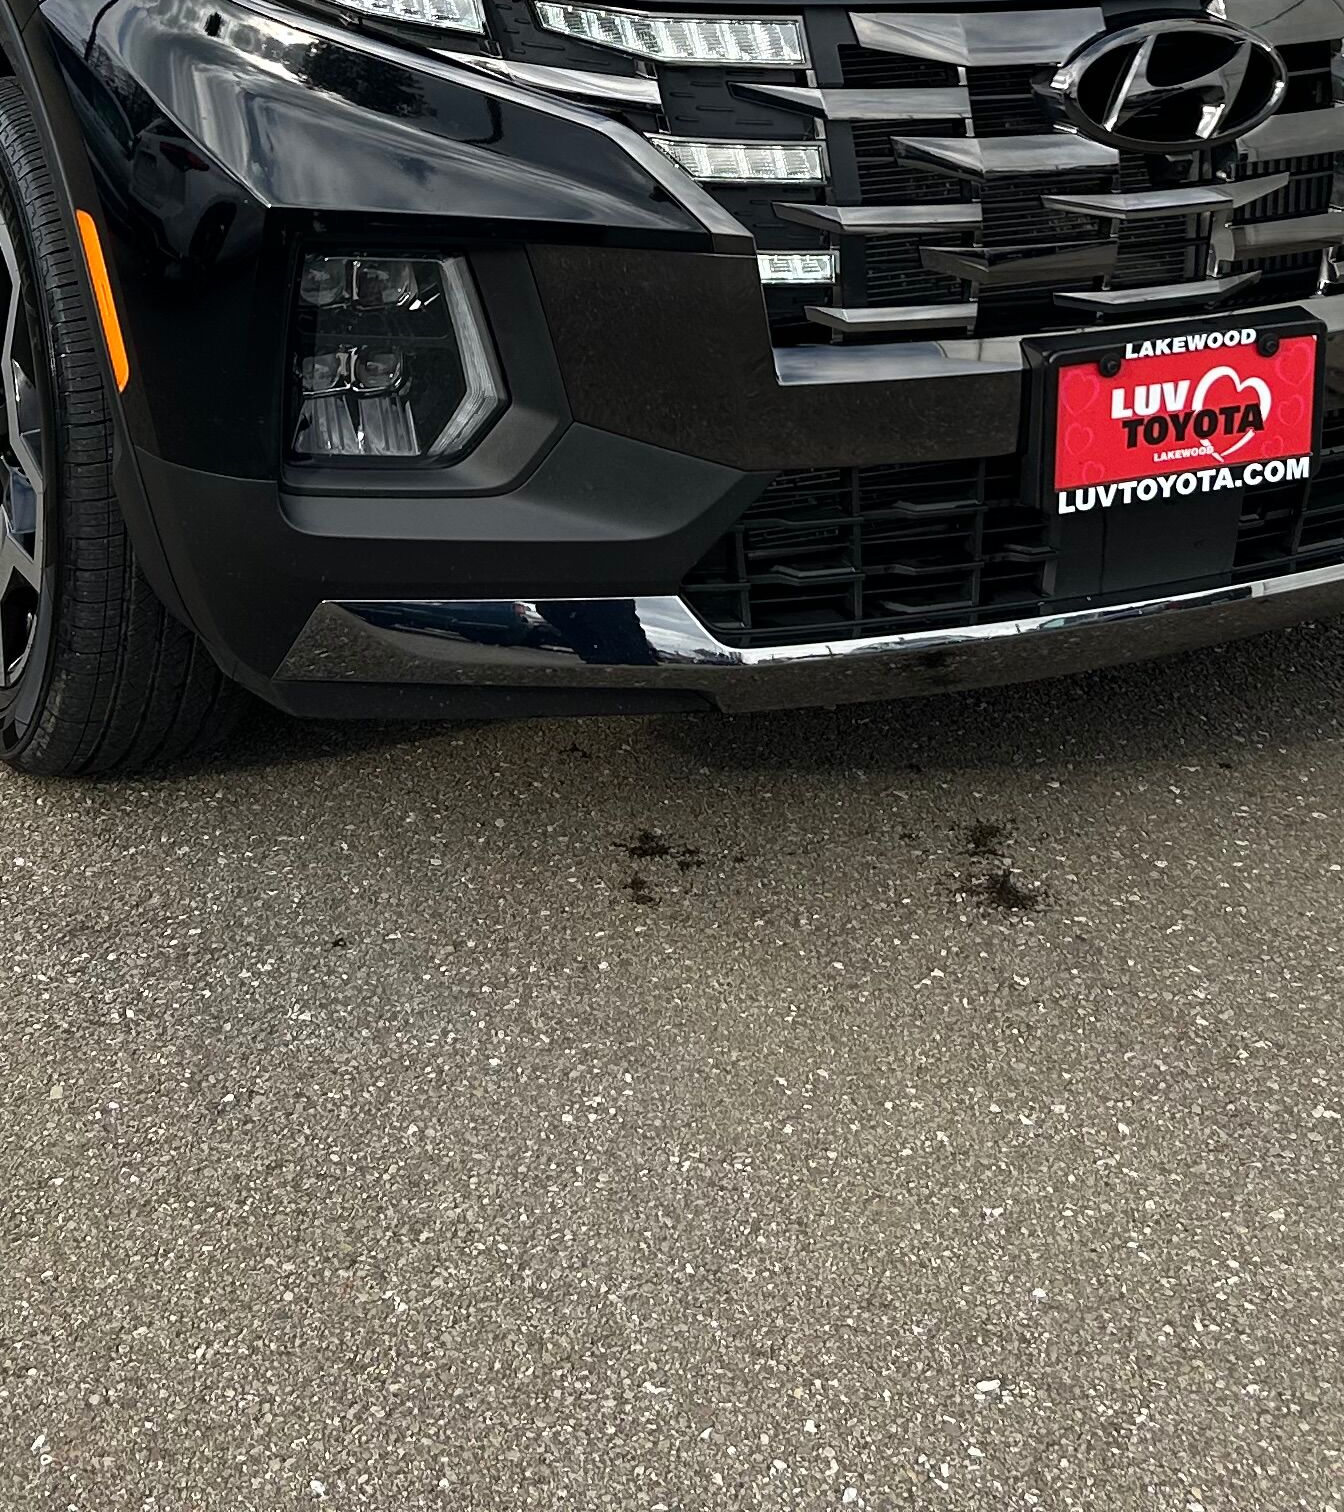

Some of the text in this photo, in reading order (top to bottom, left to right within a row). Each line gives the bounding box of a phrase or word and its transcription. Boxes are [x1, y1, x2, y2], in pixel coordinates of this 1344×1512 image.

[1125, 328, 1257, 359] LAKEWOOD
[1111, 380, 1191, 419] LUV
[1122, 404, 1264, 449] TOYOTA
[1153, 445, 1214, 463] LAKEWOOD
[1058, 456, 1310, 515] LUVTOYOTA.COM
